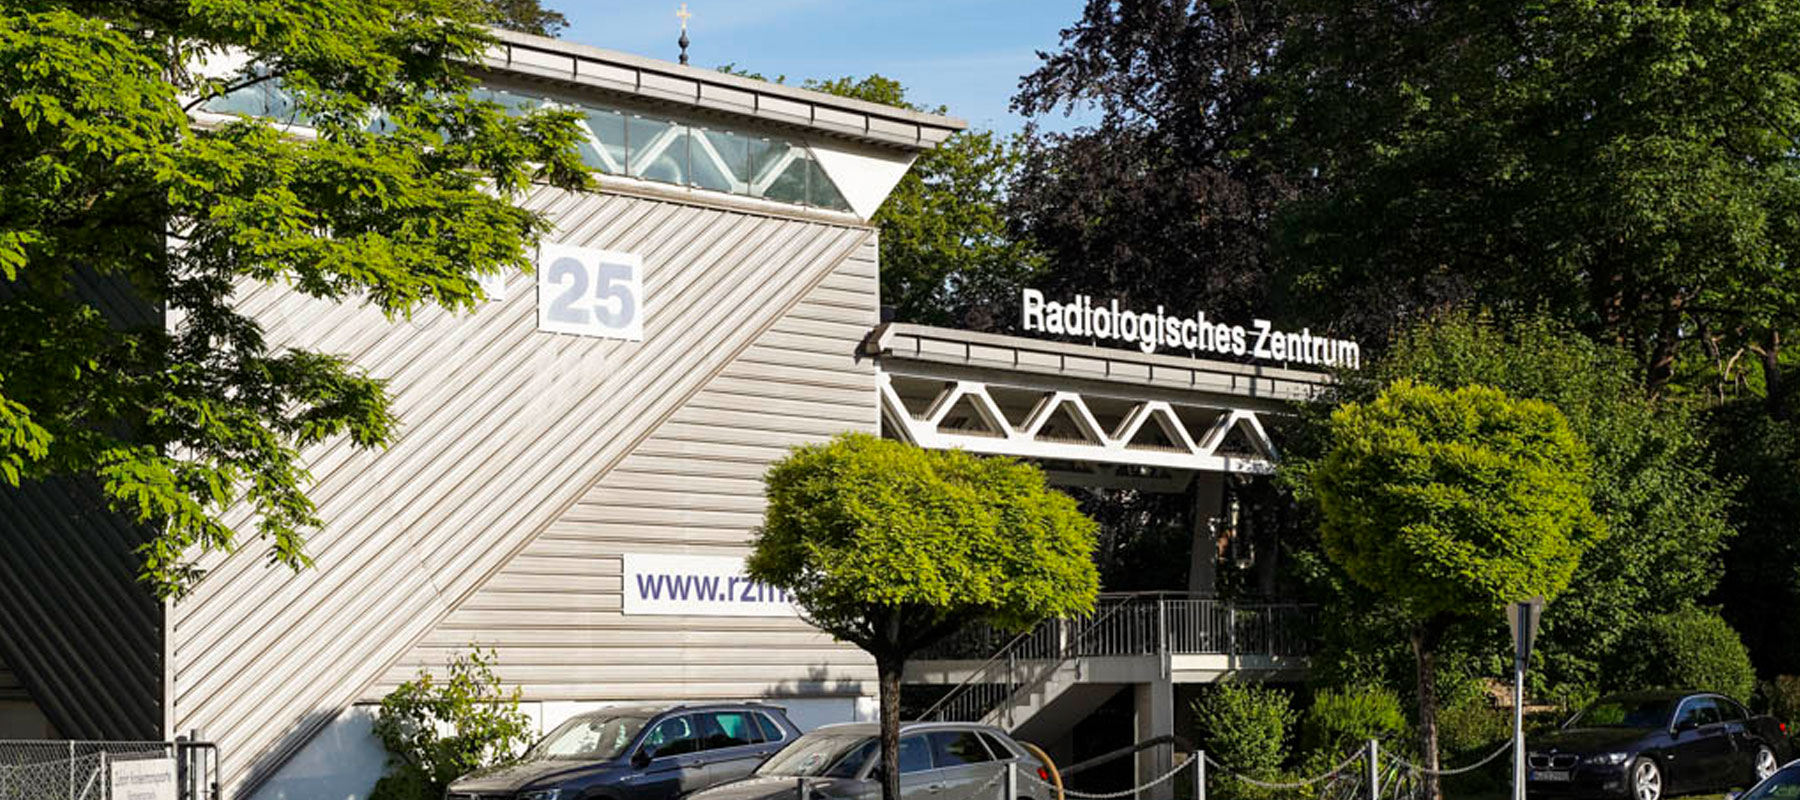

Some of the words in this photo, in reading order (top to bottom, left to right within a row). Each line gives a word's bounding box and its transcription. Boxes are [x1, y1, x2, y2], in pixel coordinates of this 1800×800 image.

[547, 257, 636, 329] 25
[1022, 288, 1247, 356] Radiologisches
[1253, 318, 1361, 370] Zentrum
